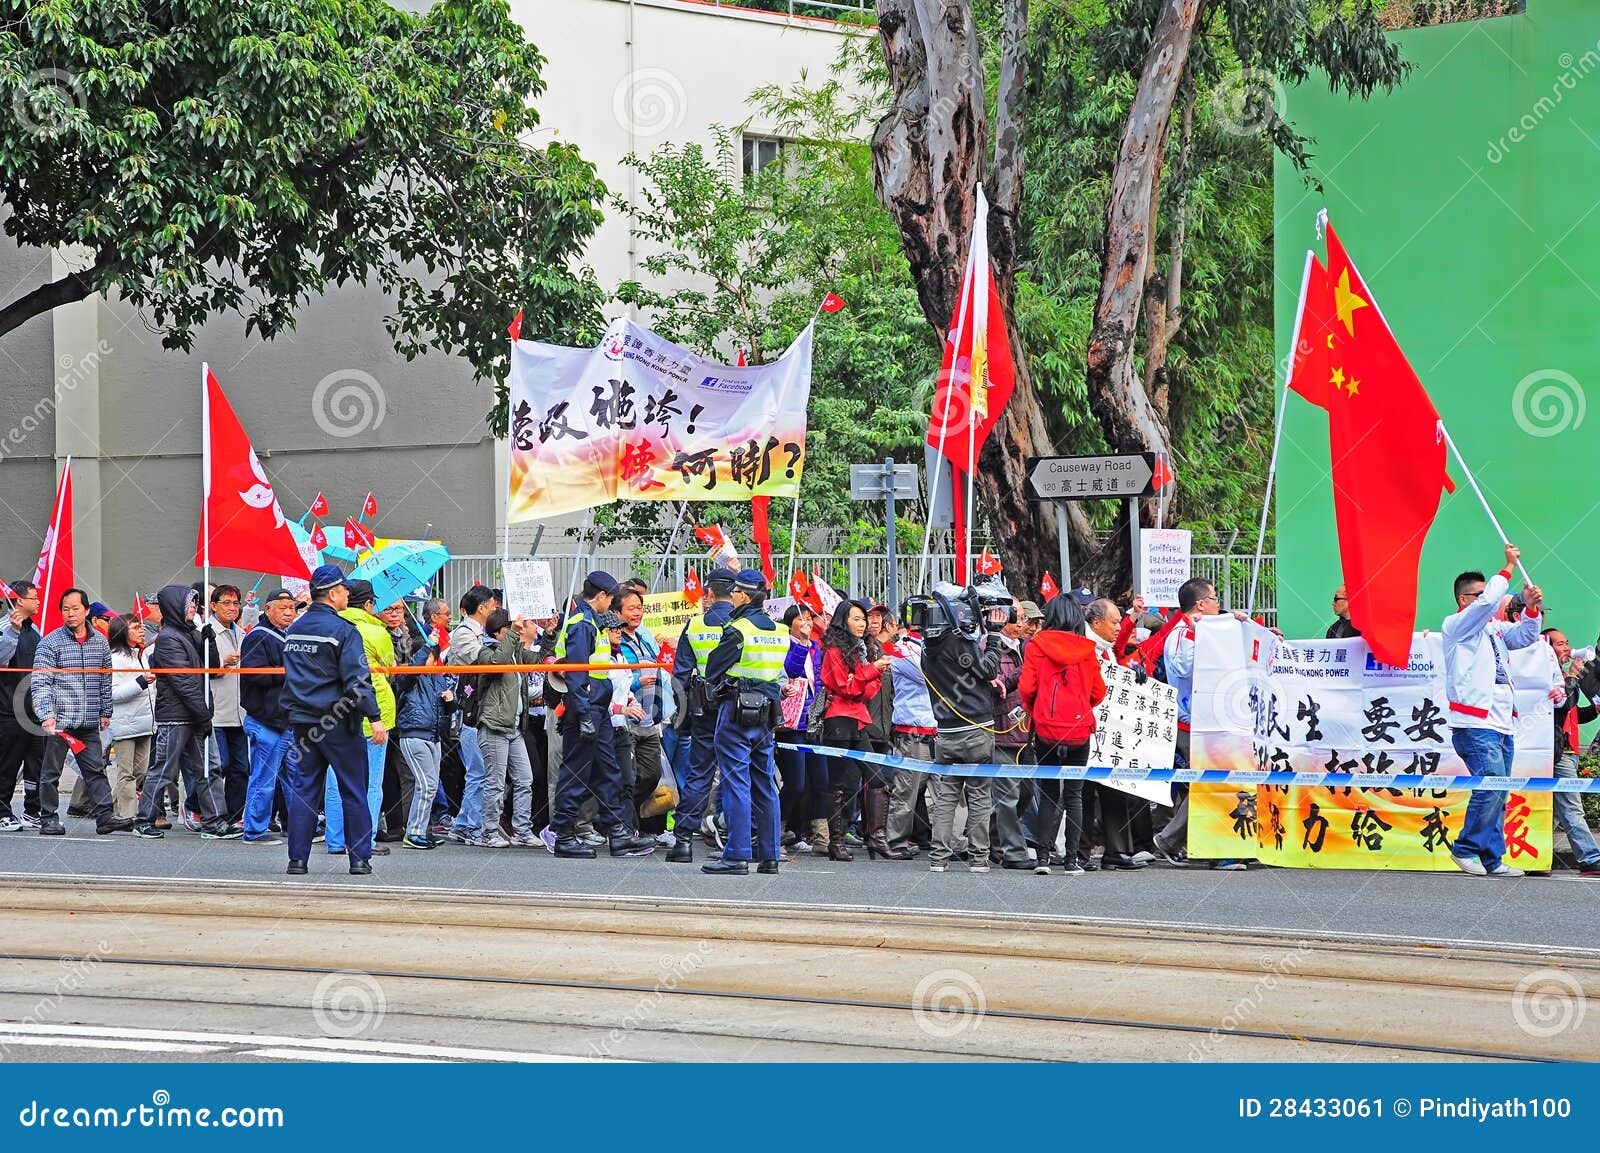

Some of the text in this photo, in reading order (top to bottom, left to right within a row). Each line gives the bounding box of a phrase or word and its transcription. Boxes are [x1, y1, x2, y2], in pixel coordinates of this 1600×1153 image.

[635, 354, 650, 367] HONG
[651, 364, 667, 374] KONG
[668, 371, 688, 383] POWER
[1049, 460, 1132, 474] Causeway Road
[1044, 483, 1056, 492] 120
[1061, 477, 1118, 493] 高士威道
[289, 644, 312, 653] POLICE
[1306, 669, 1324, 678] KONG
[1326, 668, 1349, 678] POWER
